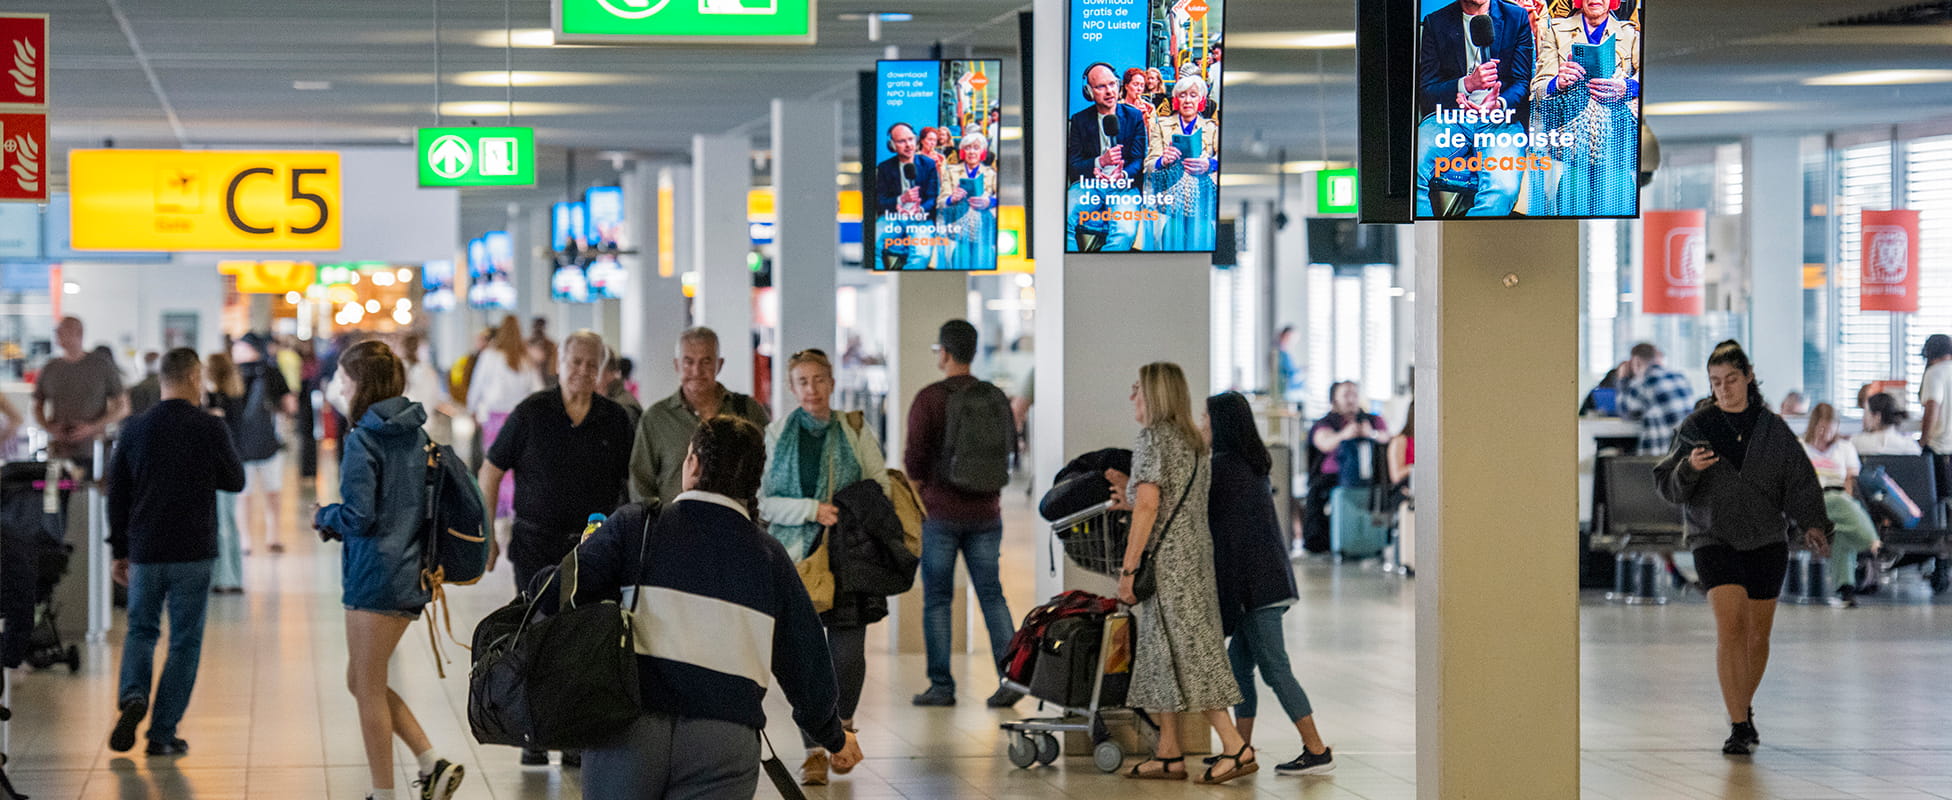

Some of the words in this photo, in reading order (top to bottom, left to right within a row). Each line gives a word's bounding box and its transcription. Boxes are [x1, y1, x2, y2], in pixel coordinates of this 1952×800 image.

[1083, 7, 1112, 18] gratis
[1115, 6, 1129, 16] de
[1082, 20, 1105, 30] NPO
[1107, 20, 1141, 30] Luister
[1082, 31, 1103, 41] app
[887, 80, 911, 89] gratis
[912, 79, 924, 87] de
[1435, 103, 1516, 124] luister
[1434, 127, 1466, 148] de
[1473, 127, 1574, 148] mooiste
[1434, 151, 1552, 178] podcasts
[1080, 174, 1134, 189] luister
[226, 167, 329, 234] C5
[1079, 191, 1101, 205] de
[1105, 191, 1174, 205] mooiste
[885, 209, 930, 221] luister
[1079, 207, 1159, 226] podcasts
[884, 222, 902, 234] de
[906, 222, 962, 234] mooiste
[884, 235, 950, 249] podcasts
